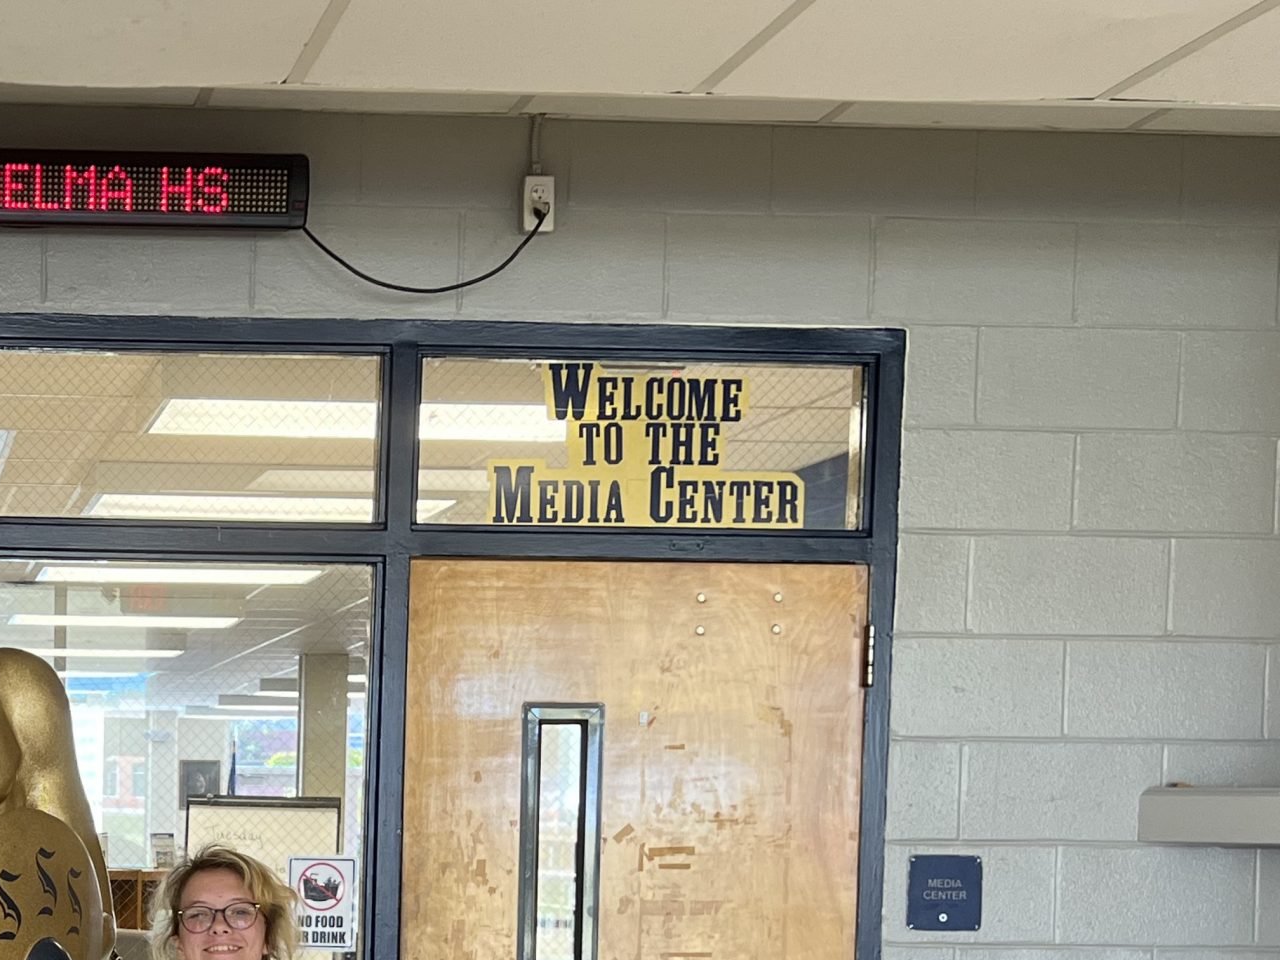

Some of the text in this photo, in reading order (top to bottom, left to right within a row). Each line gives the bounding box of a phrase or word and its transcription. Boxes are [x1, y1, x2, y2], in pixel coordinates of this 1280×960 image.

[161, 166, 228, 213] HS
[549, 363, 743, 422] WELCOME
[578, 422, 721, 466] TO THE
[492, 465, 800, 524] MEDIA CENTER
[922, 889, 968, 900] CENTER
[927, 878, 962, 888] MEDIA
[297, 914, 344, 928] NO FOOD
[311, 930, 347, 944] DRINK
